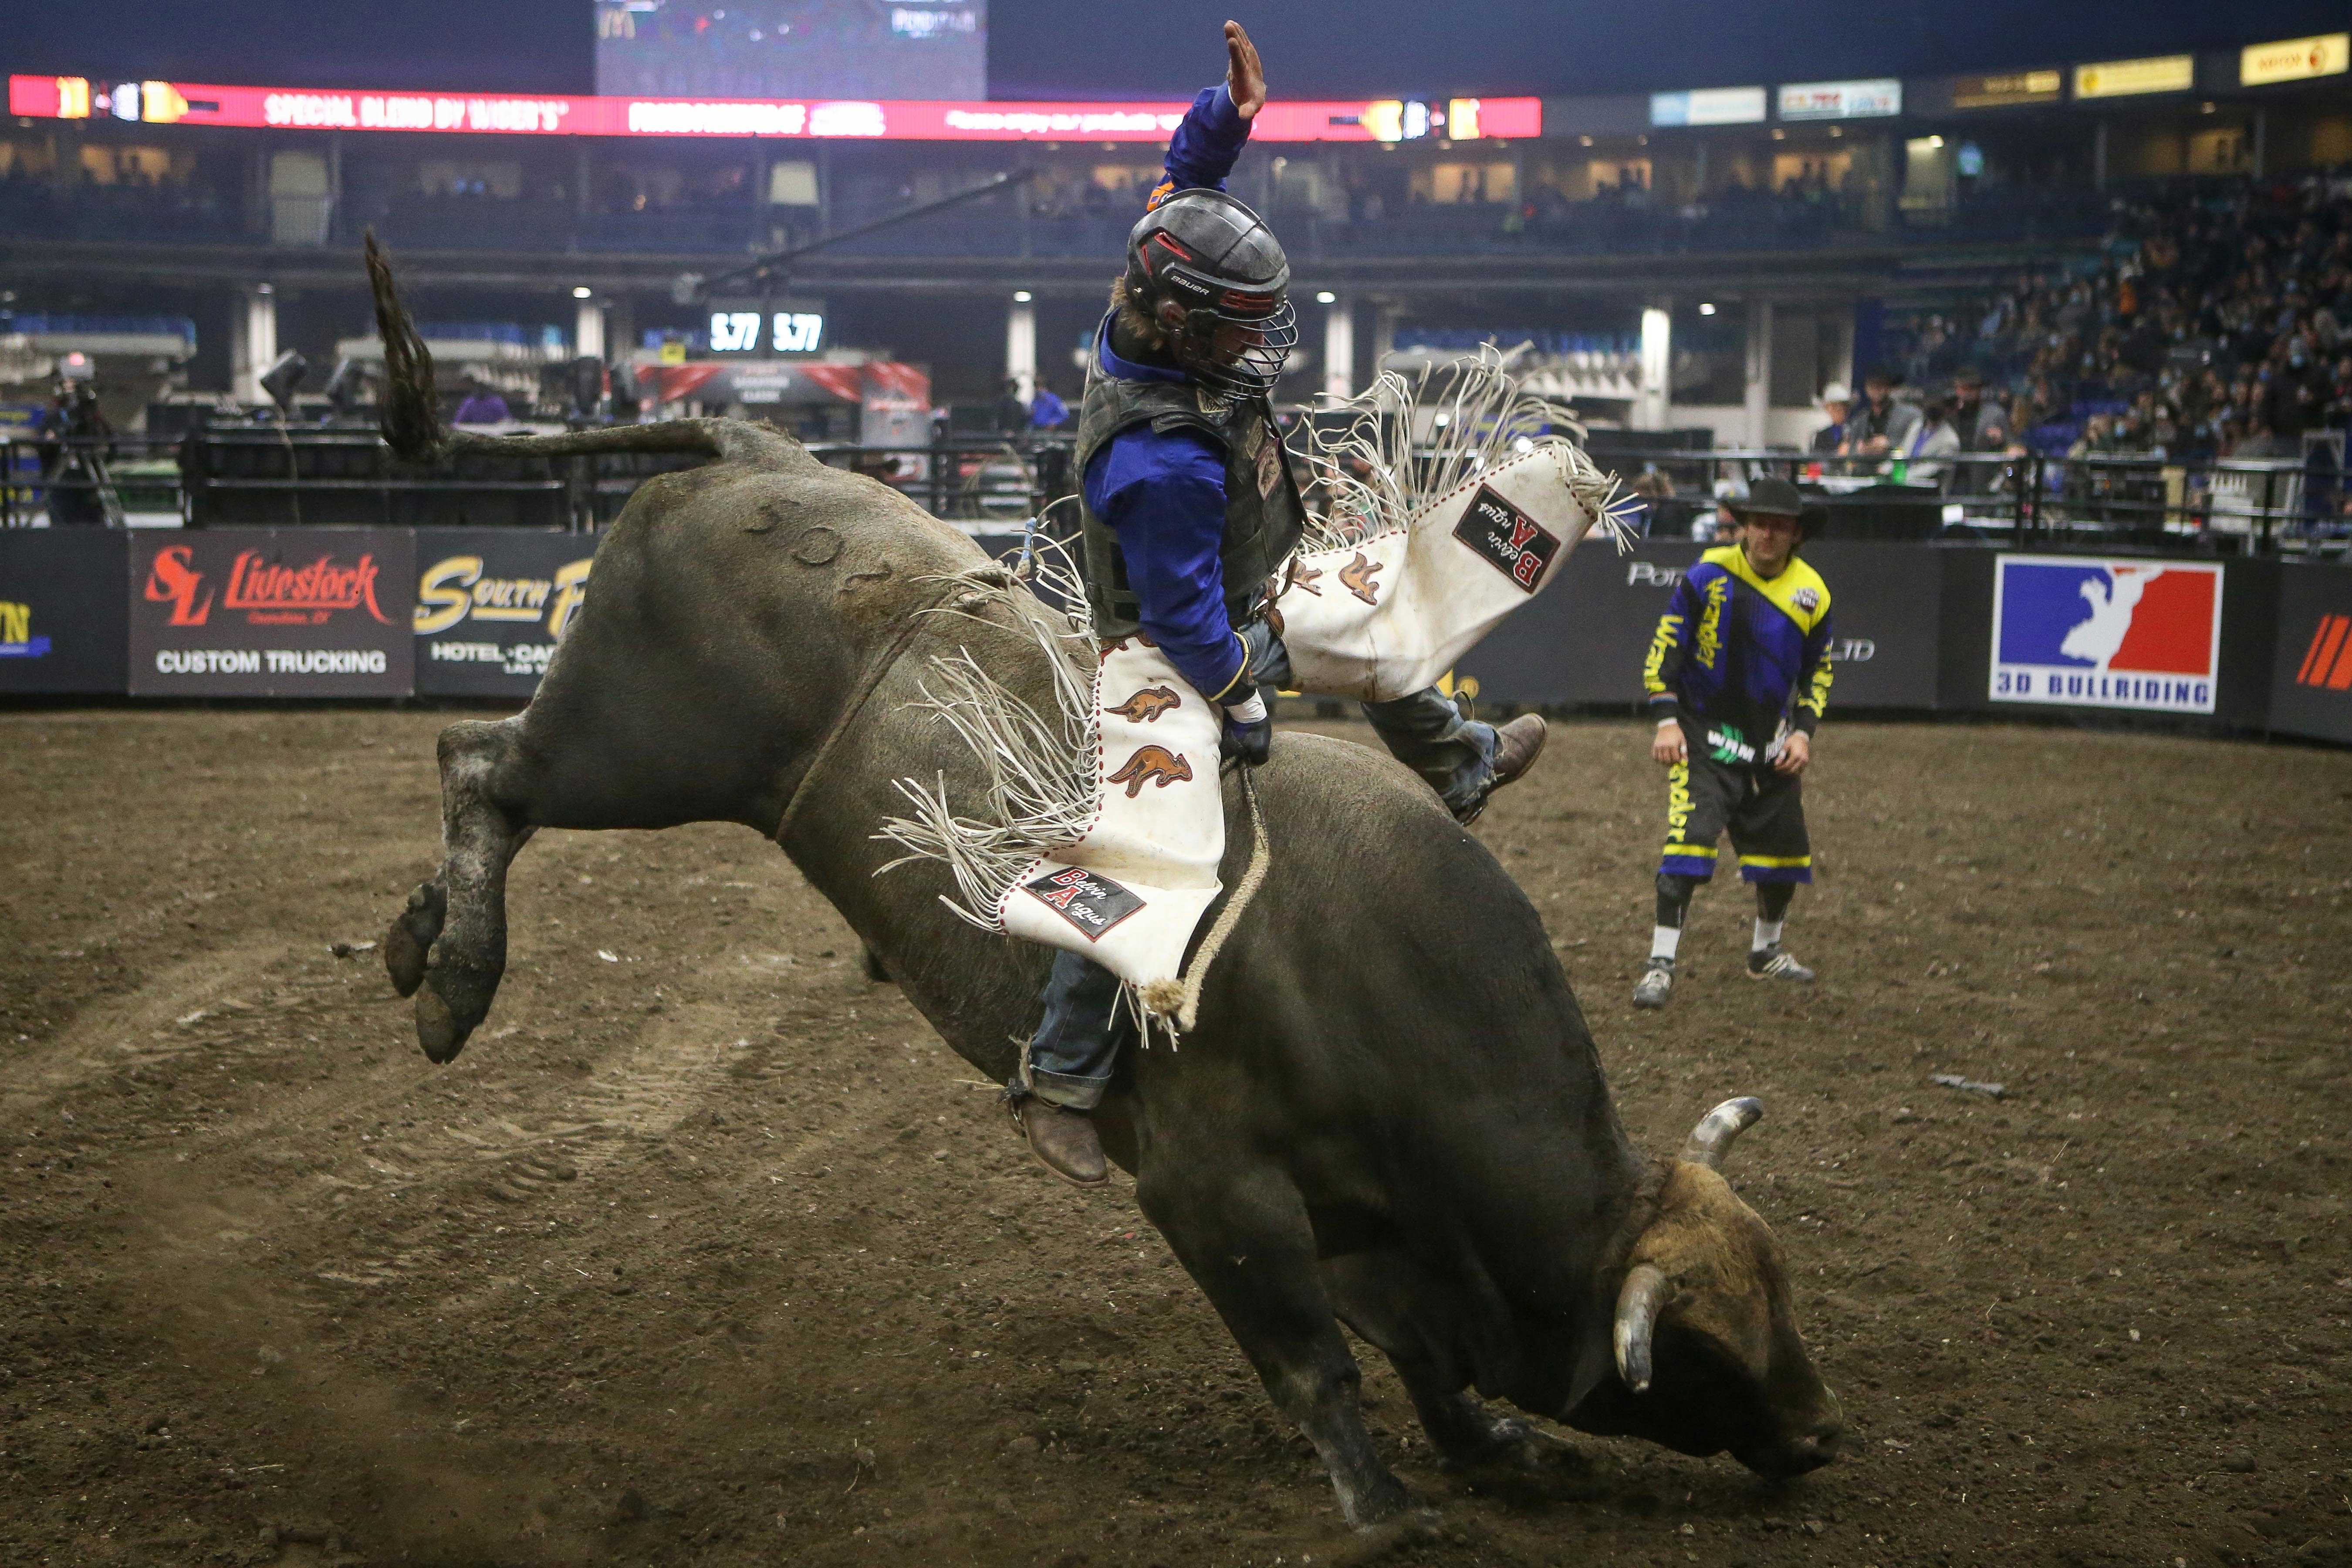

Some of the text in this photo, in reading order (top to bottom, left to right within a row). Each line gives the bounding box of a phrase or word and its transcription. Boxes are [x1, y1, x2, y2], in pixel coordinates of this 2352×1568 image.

[1171, 274, 1210, 296] BAUER
[1478, 502, 1538, 551] Angus
[1487, 531, 1542, 587] Belvin
[224, 547, 395, 625] Livestock
[413, 554, 552, 635] SOUTH
[156, 649, 387, 674] CUSTOM TRUCKING
[431, 642, 506, 662] HOTEL
[1997, 671, 2209, 706] 3D BULLRIDING
[1050, 868, 1108, 900] Belvin
[1043, 885, 1108, 926] Angus
